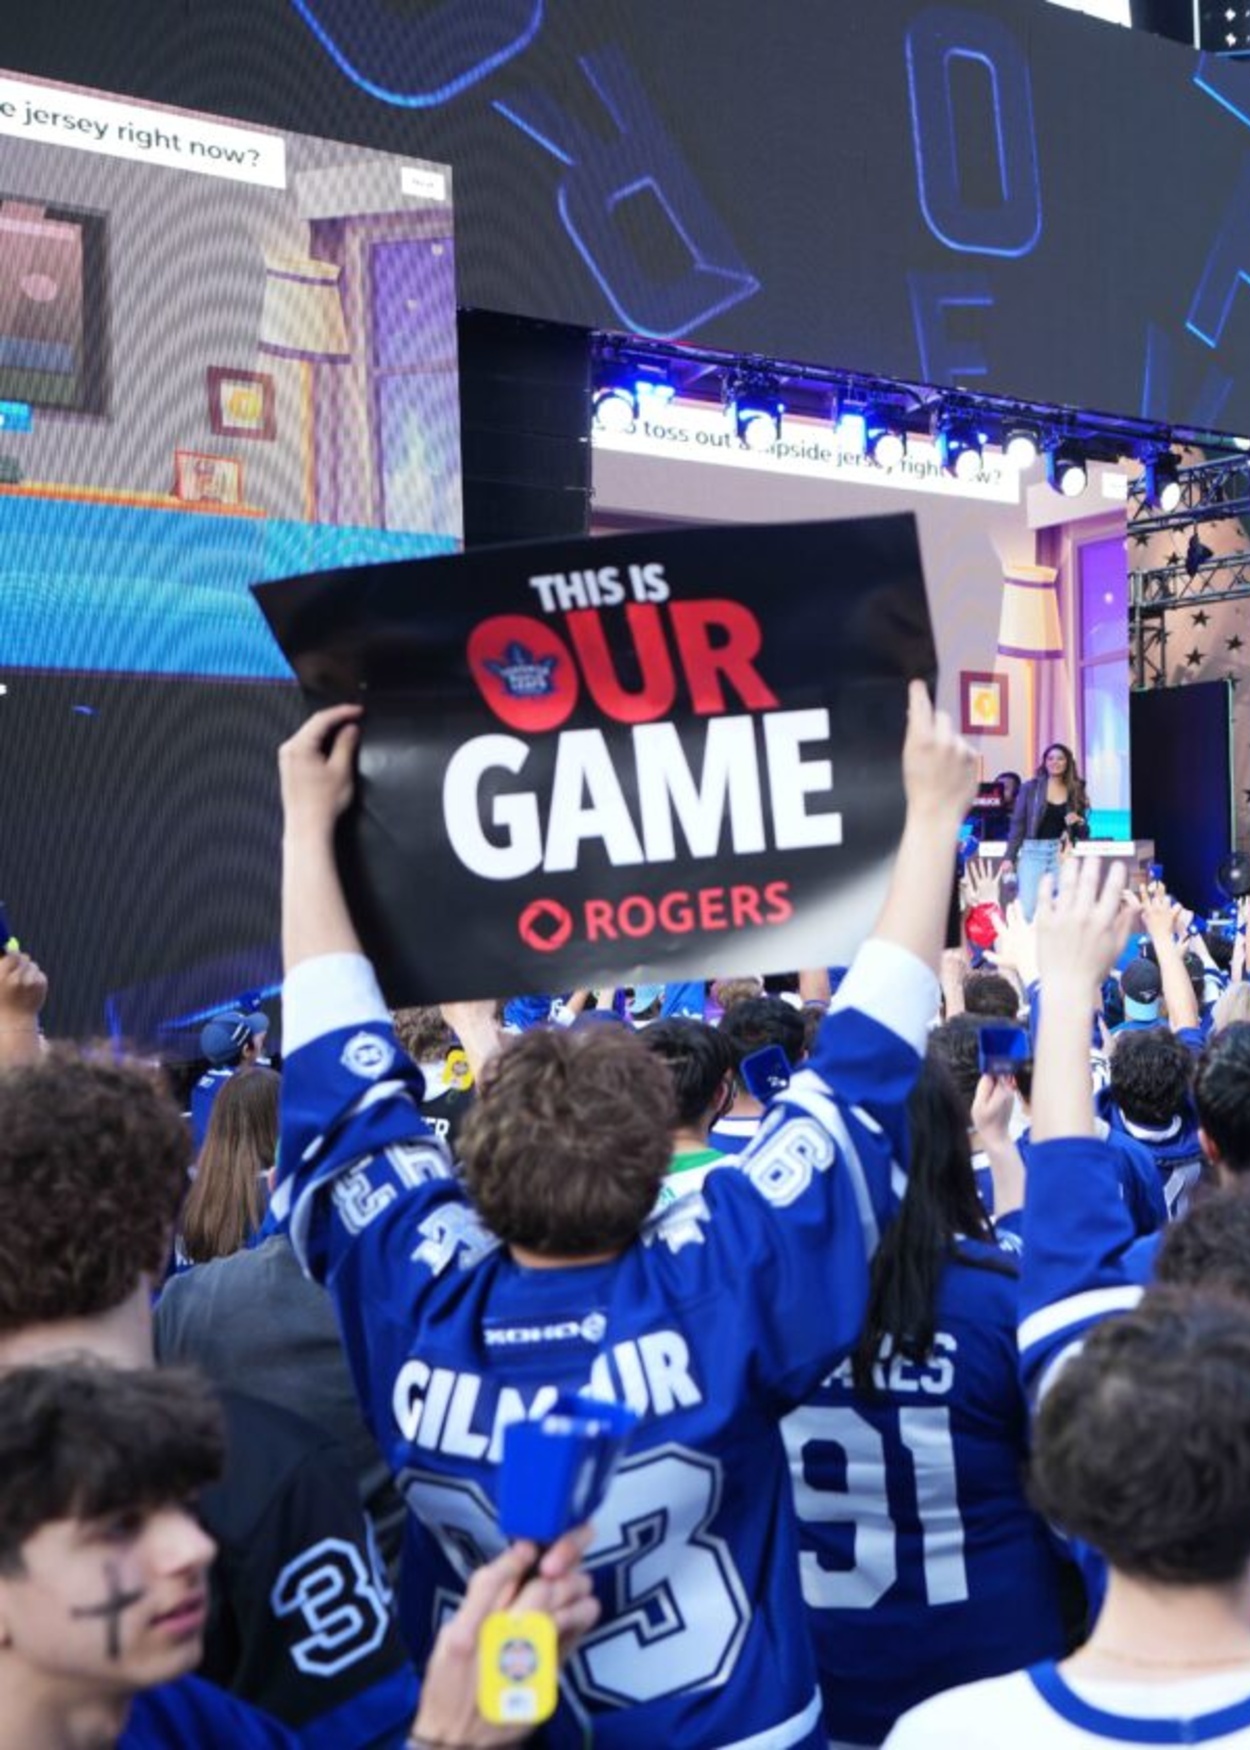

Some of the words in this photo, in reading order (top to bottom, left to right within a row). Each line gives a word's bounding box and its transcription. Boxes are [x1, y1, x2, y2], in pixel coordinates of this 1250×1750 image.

[23, 101, 109, 140] jersey
[117, 124, 182, 153] right
[189, 141, 261, 168] now?
[643, 420, 690, 443] toss
[695, 430, 732, 449] out
[529, 566, 626, 613] THIS
[628, 562, 671, 604] IS
[466, 599, 781, 733] OUR
[442, 708, 843, 881] GAME
[583, 881, 796, 942] ROGERS
[779, 1405, 969, 1609] 91
